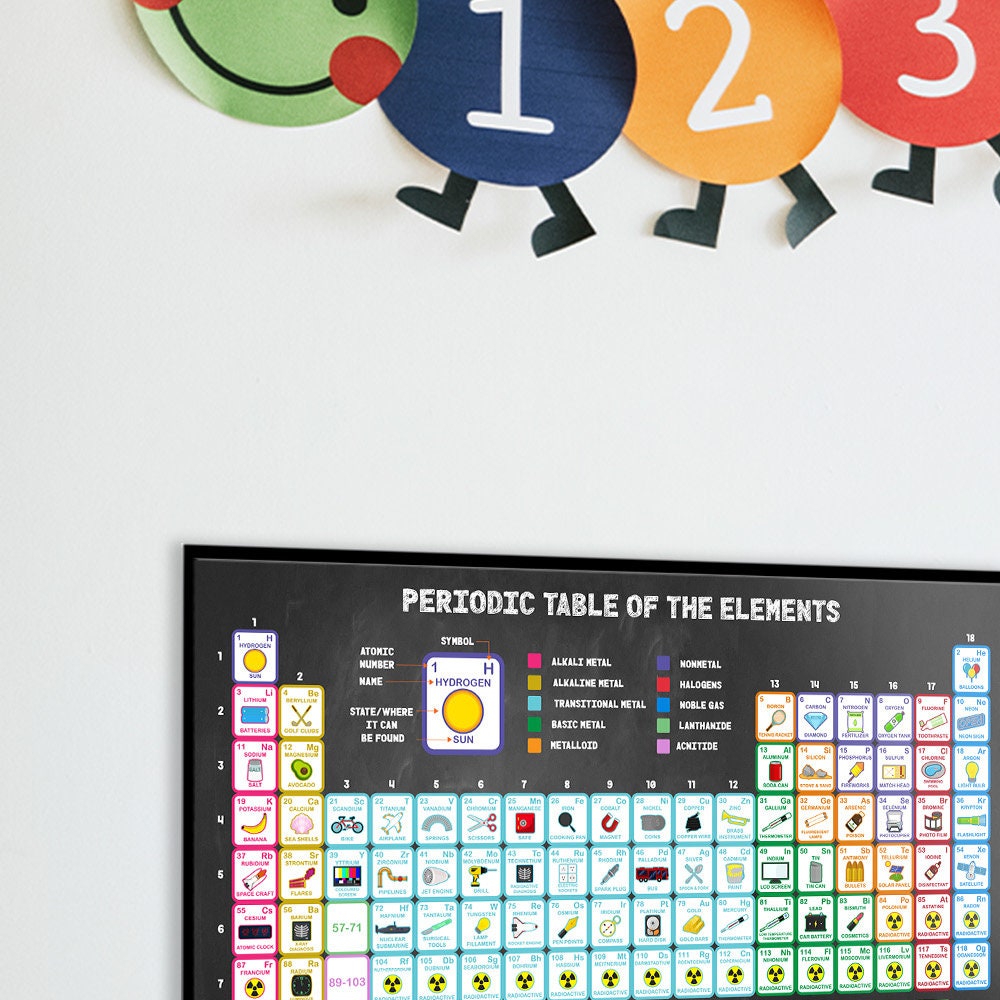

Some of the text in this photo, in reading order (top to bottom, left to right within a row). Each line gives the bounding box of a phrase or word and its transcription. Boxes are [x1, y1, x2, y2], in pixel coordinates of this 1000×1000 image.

[897, 0, 977, 98] 3
[466, 0, 555, 135] 1
[665, 0, 774, 133] 2
[402, 588, 841, 623] PERIODIC TABLE OF THE ELEMENTS
[252, 618, 257, 627] 1
[441, 637, 474, 645] SYMBOL
[966, 633, 975, 642] 18
[360, 647, 394, 656] ATOMIC
[218, 652, 223, 661] 1
[360, 660, 395, 669] NUMBER
[551, 657, 612, 667] ALKALI METAL
[680, 659, 722, 669] NONMETAL
[431, 662, 493, 675] 1 H
[297, 672, 303, 681] 2
[359, 677, 383, 686] NAME
[435, 678, 491, 687] HYDROGEN
[553, 678, 624, 688] ALKALINE METAL
[680, 680, 722, 690] HALOGENS
[770, 680, 780, 688] 13
[810, 680, 820, 689] 14
[849, 681, 858, 689] 15
[888, 681, 898, 690] 16
[927, 682, 936, 691] 17
[554, 699, 647, 709] TRANSITIONAL METAL
[680, 701, 725, 710] NOBLE GAS
[218, 707, 224, 715] 2
[350, 707, 413, 716] STATE/WHERE
[366, 721, 398, 729] IT CAN
[551, 720, 606, 730] BASIC METAL
[679, 721, 732, 731] LANTHANIDE
[361, 734, 405, 742] BE FOUND
[453, 735, 474, 744] SUN
[550, 741, 598, 750] METALLOID
[676, 741, 718, 751] ACNITIDE
[218, 761, 224, 770] 3
[343, 780, 350, 789] 3
[389, 780, 395, 789] 4
[433, 780, 440, 789] 5
[477, 780, 484, 789] 6
[521, 780, 527, 789] 7
[564, 780, 570, 789] 8
[607, 780, 613, 789] 9
[646, 780, 656, 789] 10
[688, 780, 696, 789] 11
[728, 780, 738, 789] 12
[217, 815, 224, 825] 4
[217, 870, 224, 879] 5
[218, 925, 224, 934] 6
[332, 923, 362, 933] 57-71
[218, 979, 224, 988] 7
[329, 977, 366, 988] 89-103
